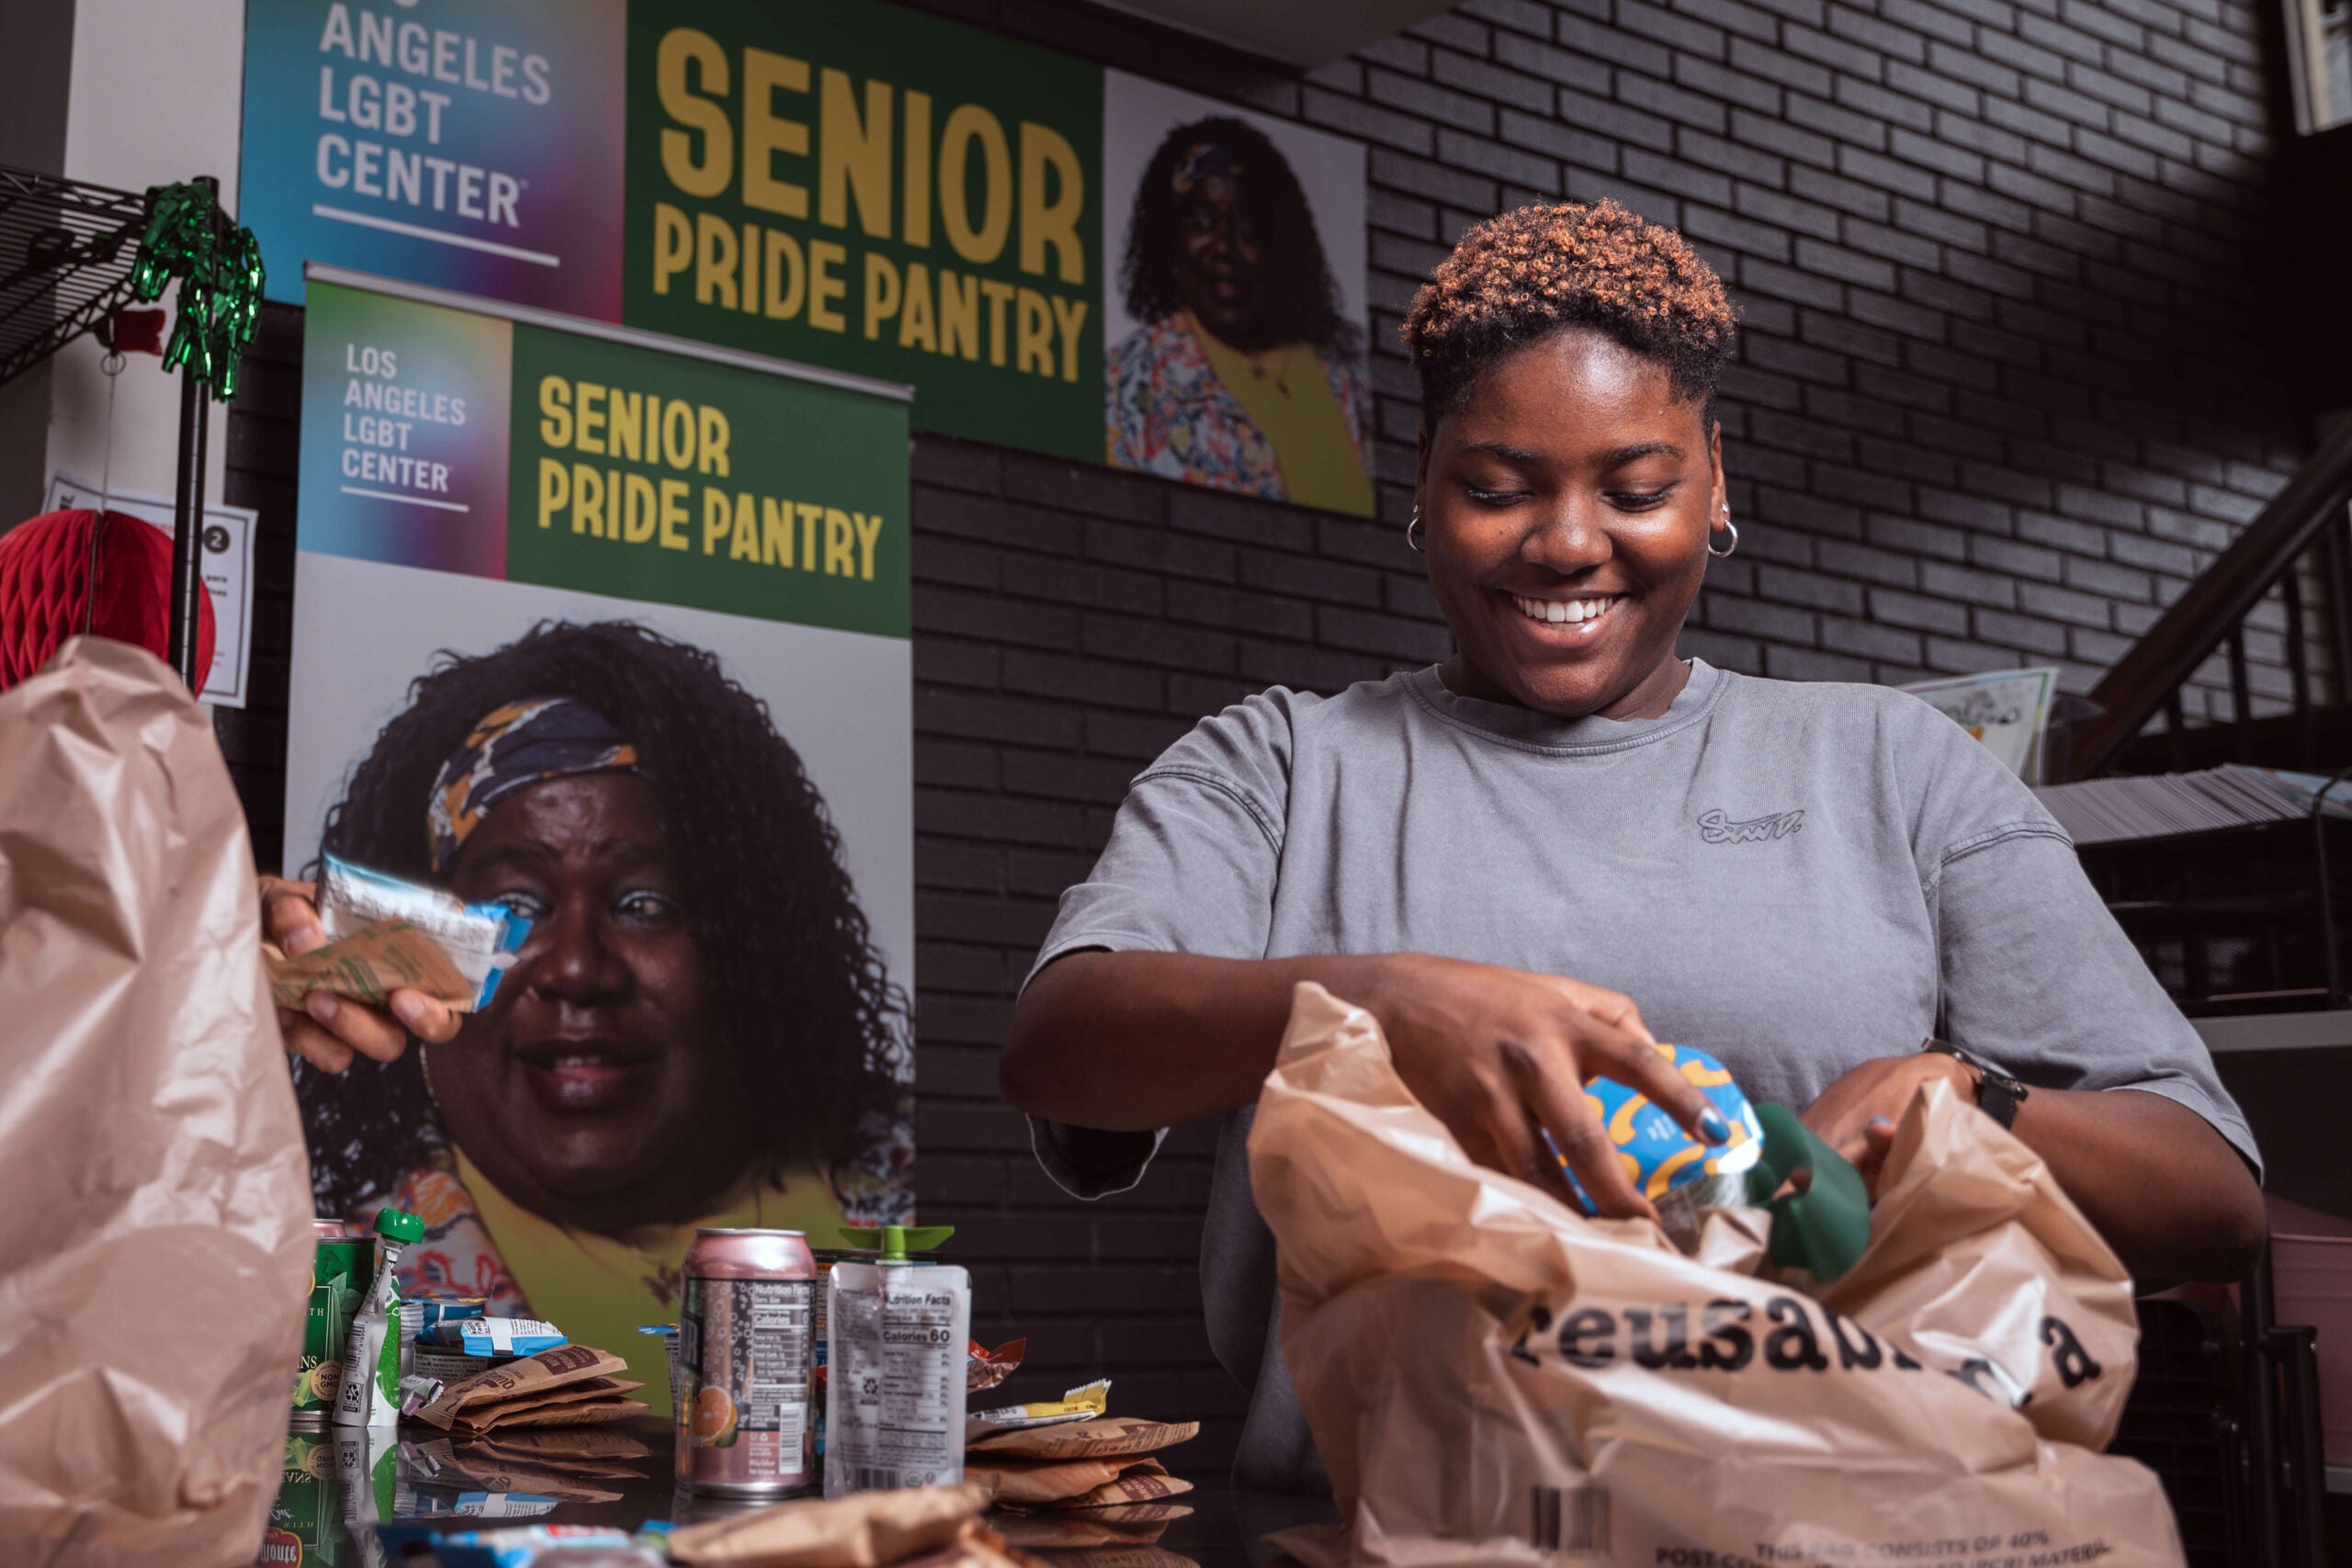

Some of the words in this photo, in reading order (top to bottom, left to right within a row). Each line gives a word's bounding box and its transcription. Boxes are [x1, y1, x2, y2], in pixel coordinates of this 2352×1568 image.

[319, 2, 550, 107] ANGELES
[319, 65, 451, 144] LGBT
[316, 132, 521, 229] CENTER
[657, 27, 1084, 287] SENIOR
[652, 202, 846, 333] PRIDE
[865, 251, 1089, 383] PANTRY
[346, 343, 397, 379] LOS
[344, 378, 467, 426] ANGELES
[344, 412, 413, 451] LGBT
[538, 375, 731, 478] SENIOR
[342, 447, 448, 493] CENTER
[210, 531, 223, 548] 2
[537, 458, 690, 552] PRIDE
[702, 491, 883, 582] PANTRY
[883, 1330, 928, 1342] Calories
[930, 1328, 951, 1343] 60
[321, 1373, 340, 1382] NON
[1973, 1533, 2002, 1552] OF
